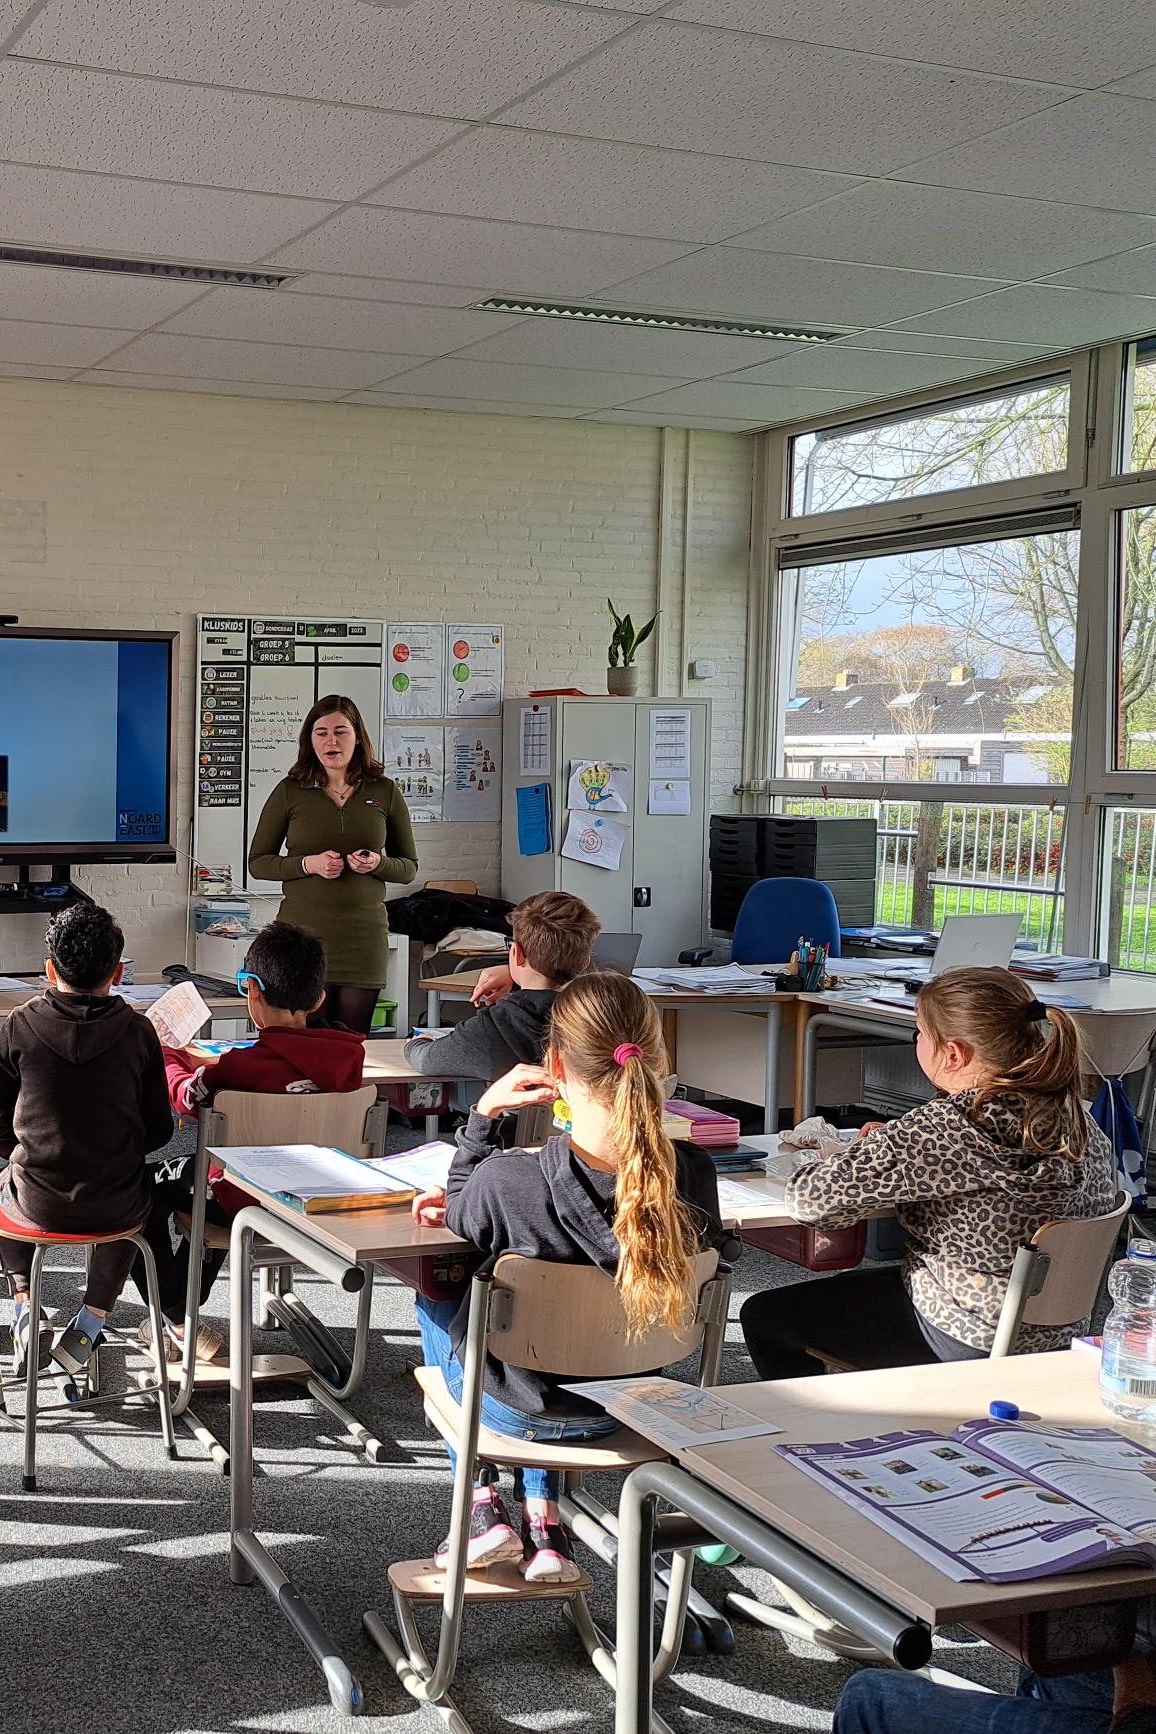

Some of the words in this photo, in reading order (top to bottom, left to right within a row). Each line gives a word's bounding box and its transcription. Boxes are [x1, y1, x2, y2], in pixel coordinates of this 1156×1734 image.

[204, 620, 244, 630] KLUSKIDS
[260, 640, 282, 648] GROEP
[284, 640, 289, 648] 5
[119, 813, 162, 824] NOARD
[119, 825, 149, 836] EAST
